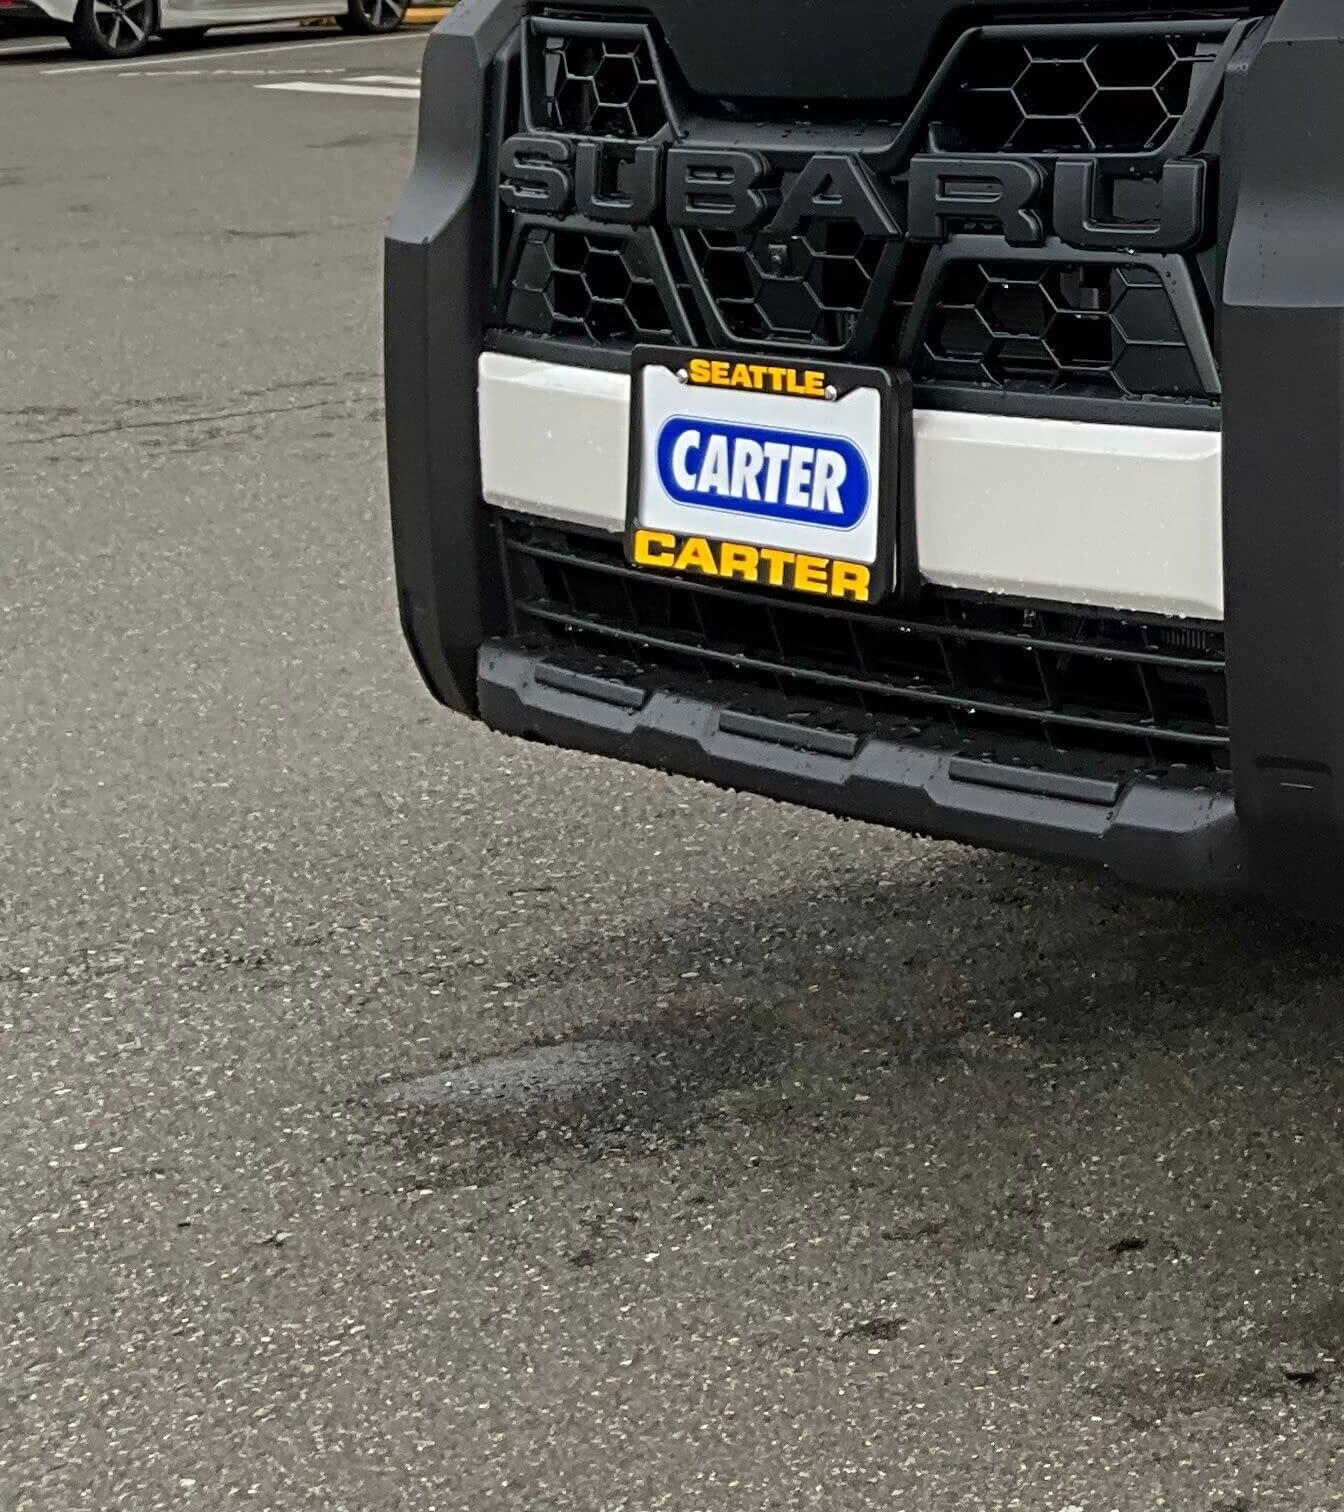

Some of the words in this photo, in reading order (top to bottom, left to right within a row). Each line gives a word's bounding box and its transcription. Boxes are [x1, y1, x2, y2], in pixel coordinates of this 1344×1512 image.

[501, 133, 1217, 253] SUBARU
[689, 358, 826, 397] SEATTLE
[671, 429, 848, 515] CARTER
[634, 529, 870, 602] CARTER
